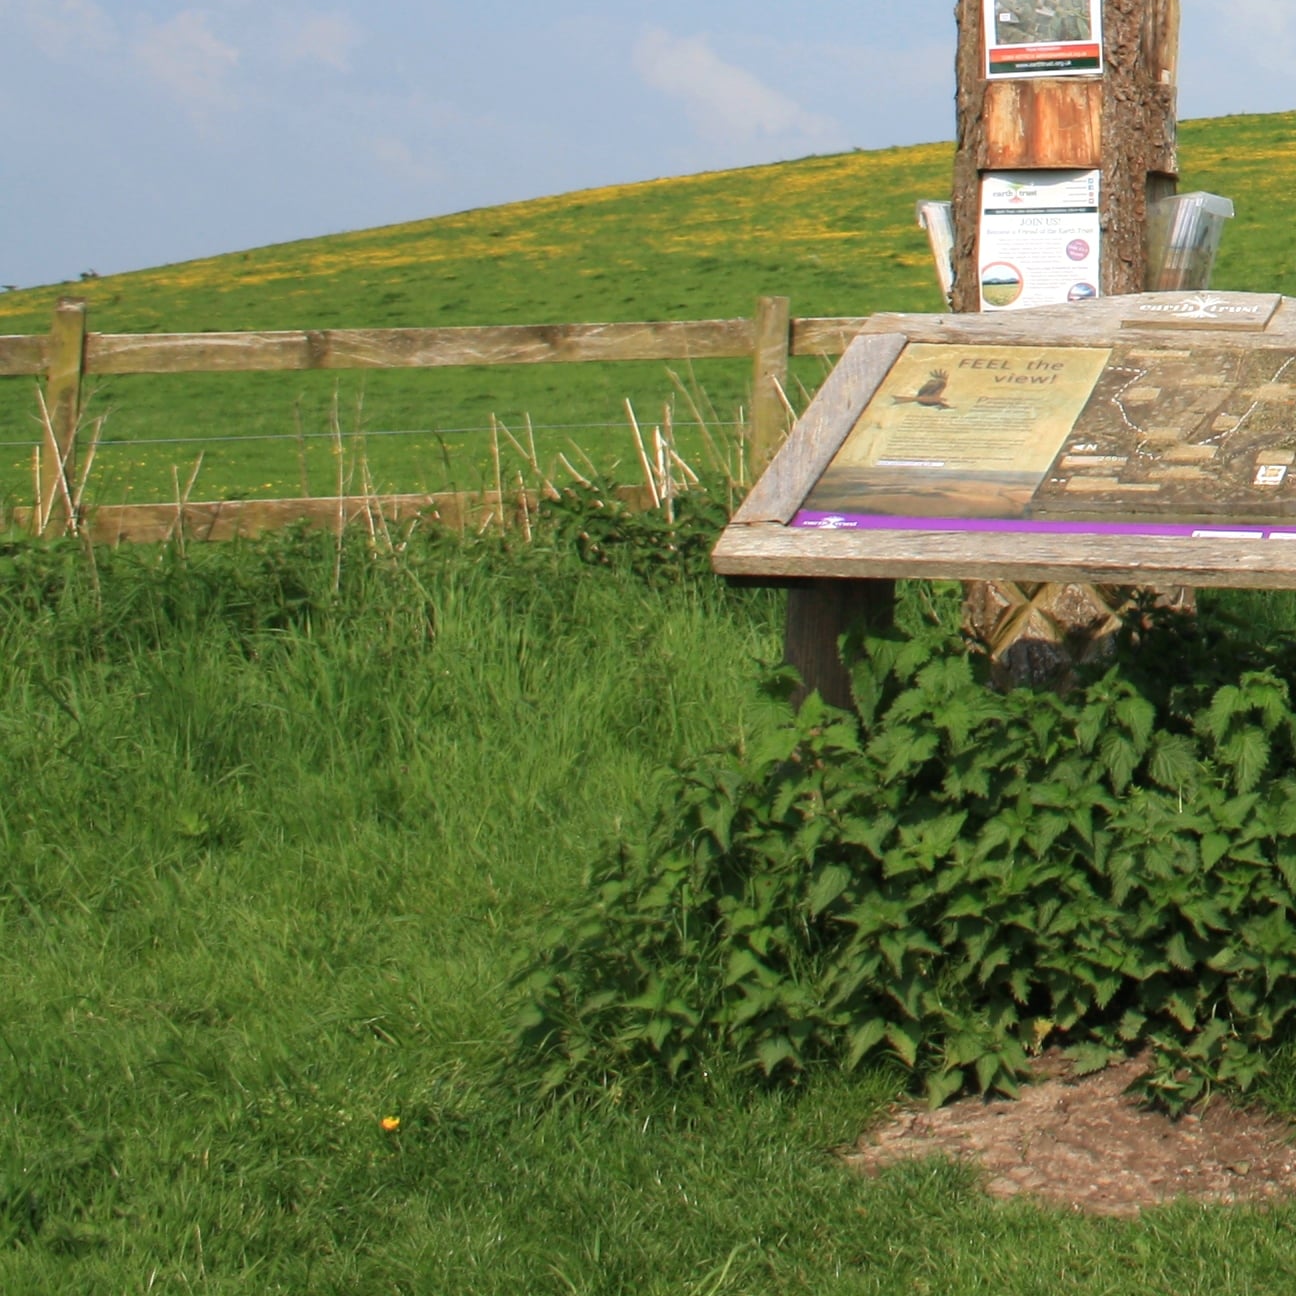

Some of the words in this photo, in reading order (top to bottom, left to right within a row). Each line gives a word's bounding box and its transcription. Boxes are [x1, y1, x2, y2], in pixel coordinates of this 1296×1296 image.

[1020, 217, 1043, 227] JOIN
[1140, 303, 1194, 312] earth
[1210, 304, 1259, 313] trust
[958, 358, 1011, 370] FEEL
[1026, 360, 1064, 371] the
[994, 372, 1057, 385] view!
